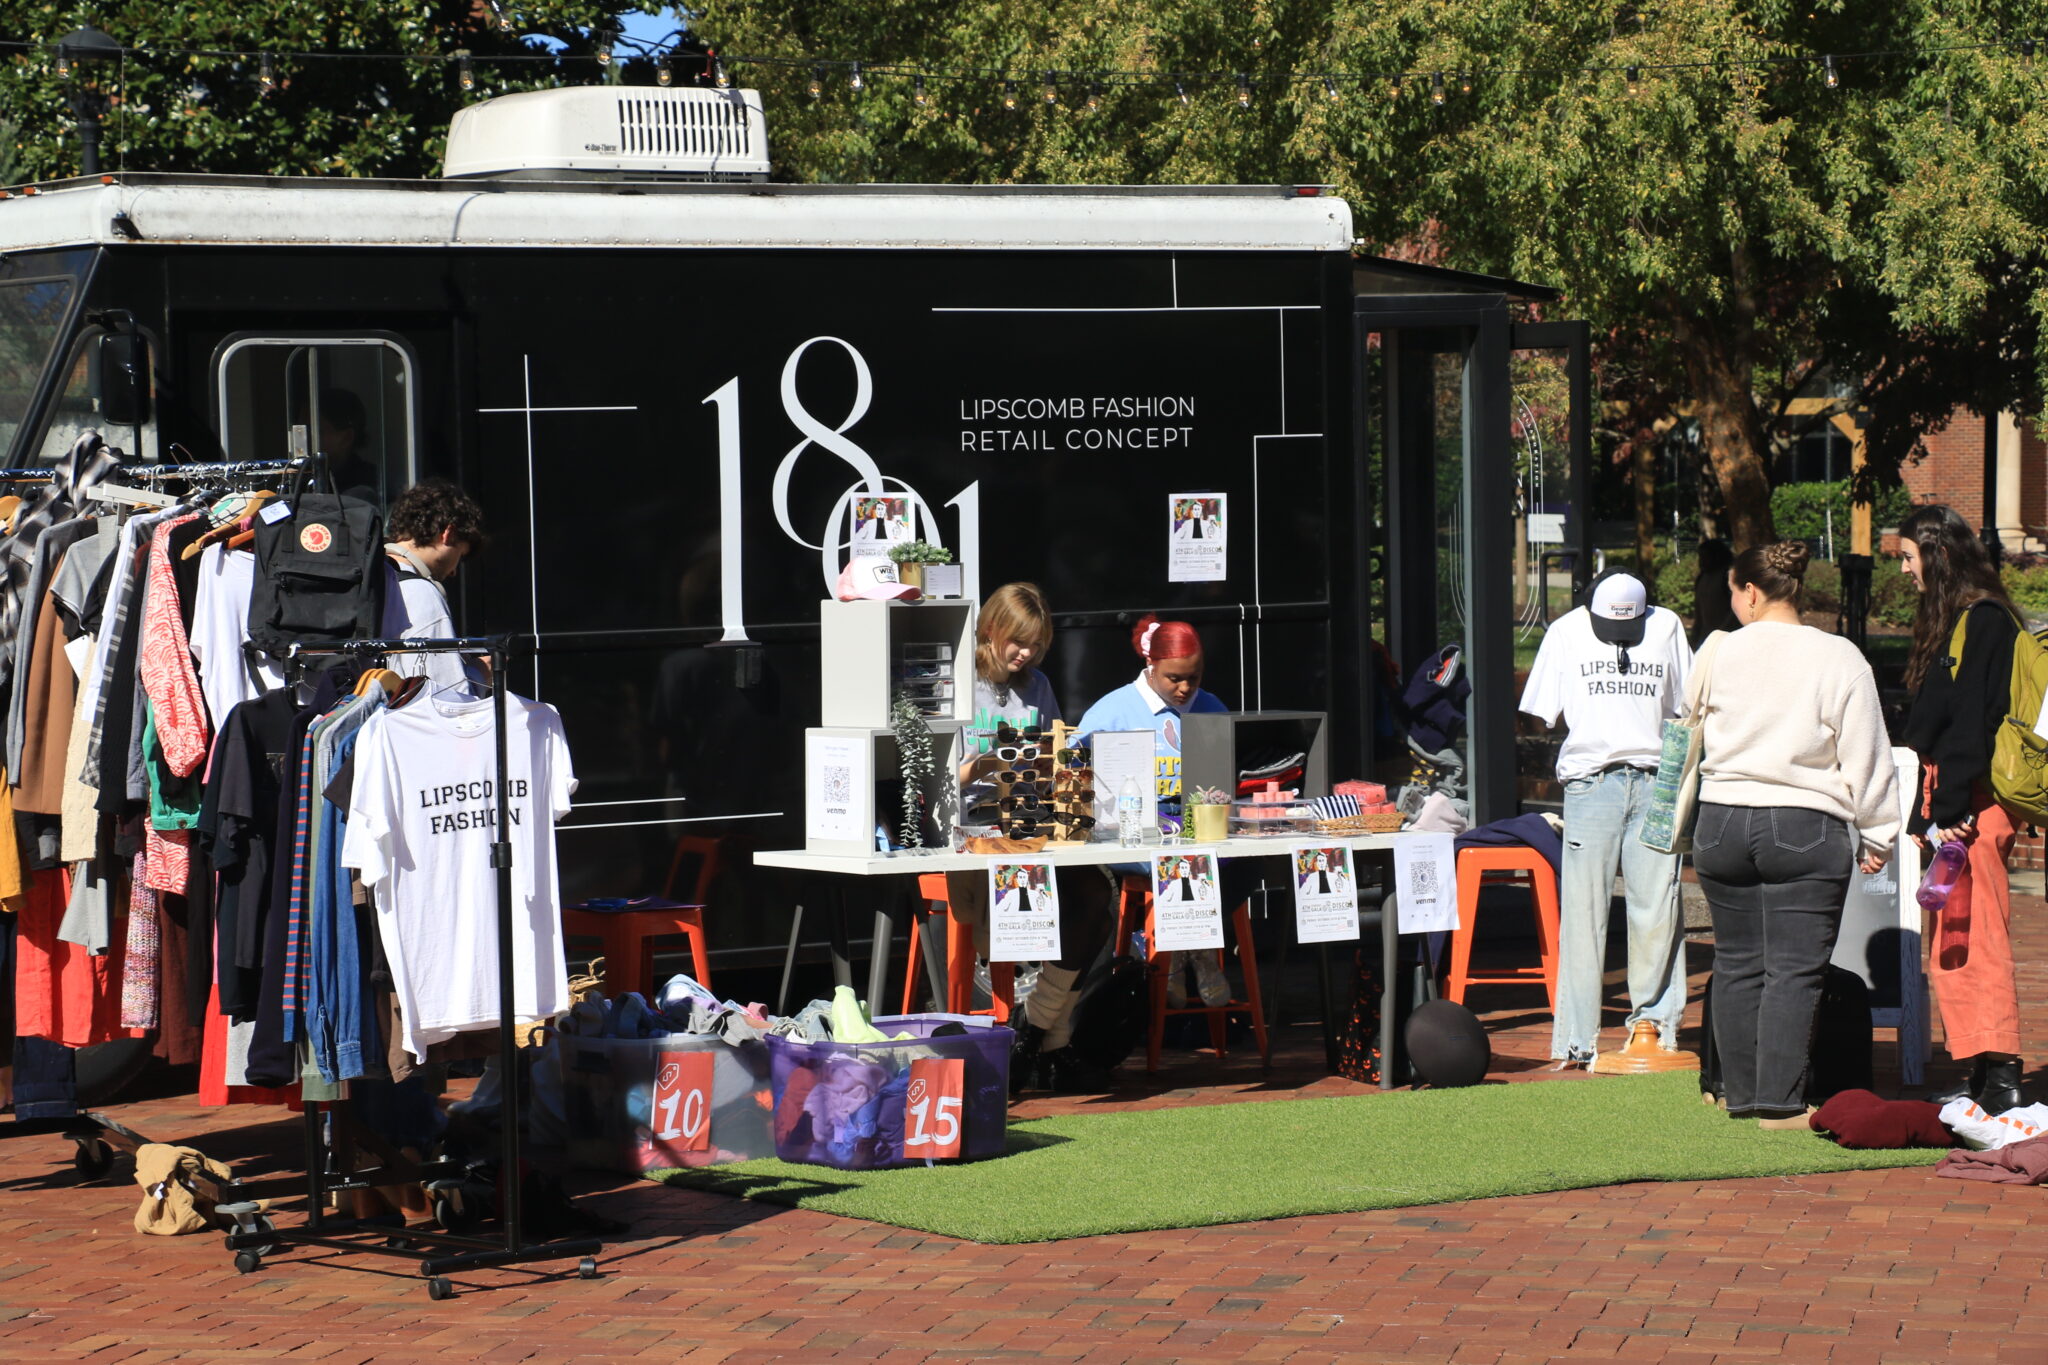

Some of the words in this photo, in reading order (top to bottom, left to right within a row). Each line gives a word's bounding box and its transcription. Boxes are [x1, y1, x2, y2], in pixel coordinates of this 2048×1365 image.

[962, 398, 1085, 419] LIPSCOMB
[1093, 397, 1194, 417] FASHION
[962, 430, 1055, 451] RETAIL
[1066, 428, 1192, 449] CONCEPT
[1580, 660, 1663, 678] LIPSOMB
[1588, 681, 1656, 696] FASHION
[656, 1088, 704, 1140] 10
[905, 1096, 962, 1146] 15
